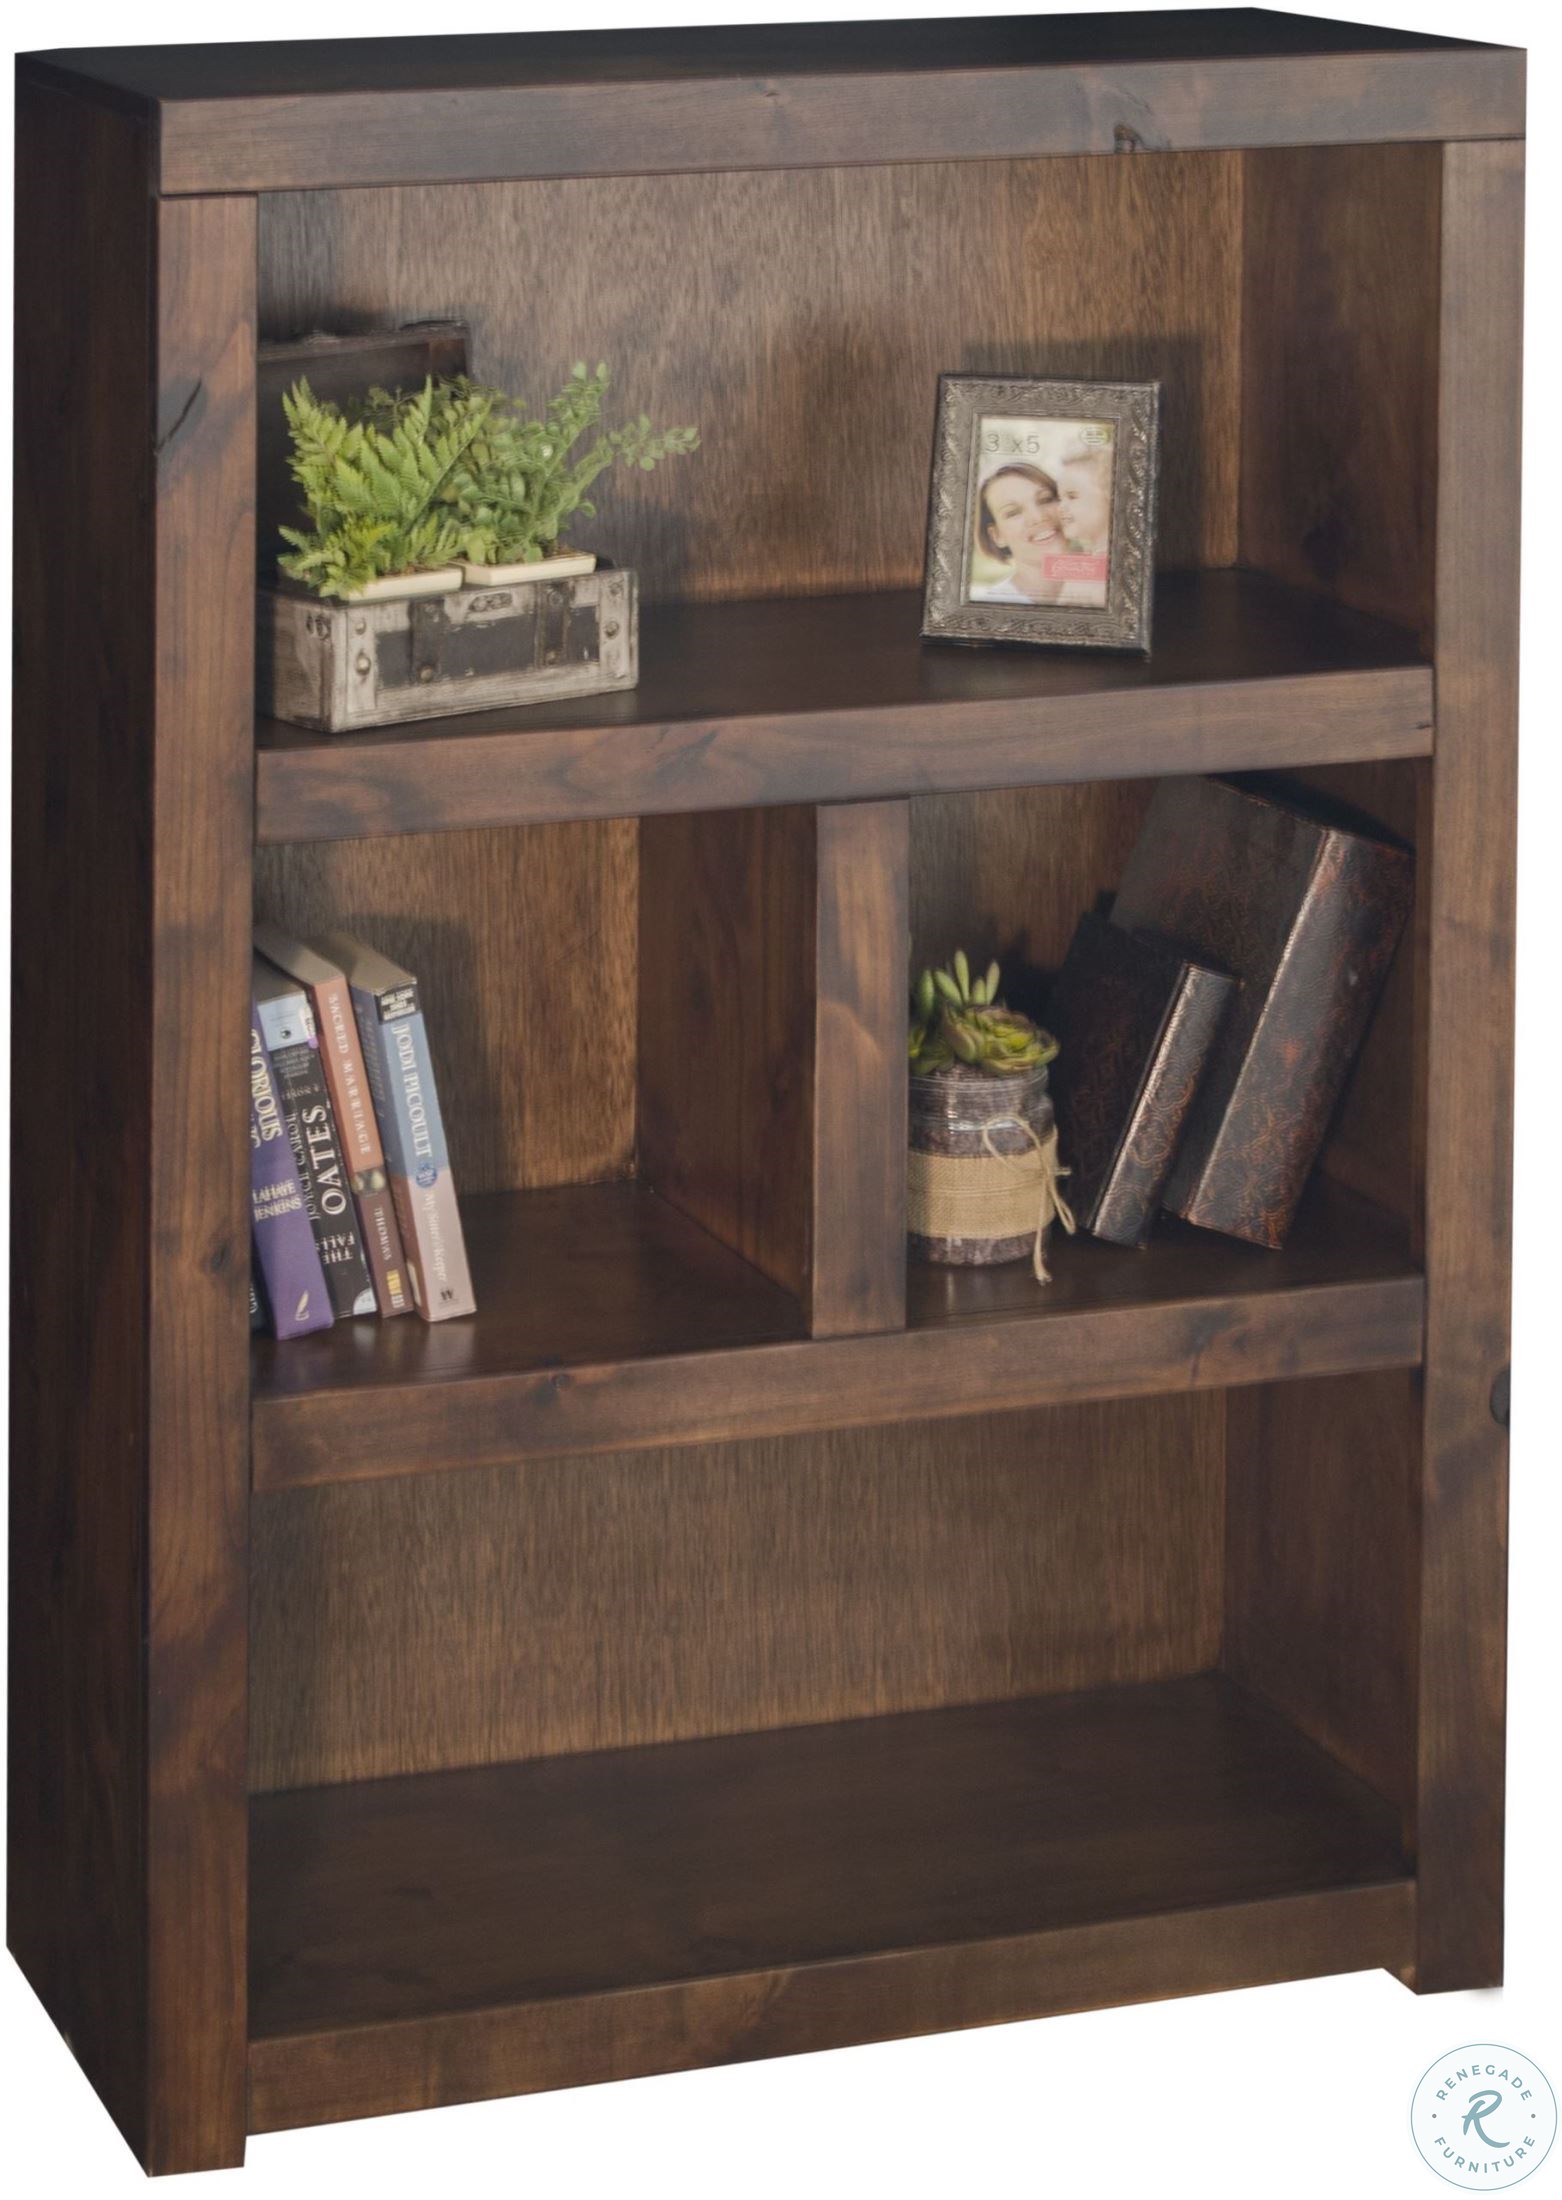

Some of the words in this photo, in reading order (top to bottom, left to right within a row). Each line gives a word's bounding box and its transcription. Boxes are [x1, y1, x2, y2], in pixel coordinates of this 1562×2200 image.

[985, 434, 1000, 453] 3
[328, 992, 349, 1055] SACRED
[343, 1063, 371, 1155] MARRIAGE
[391, 1023, 417, 1072] JODI
[403, 1072, 432, 1158] PICOULT
[302, 1104, 347, 1215] OATES
[322, 1246, 354, 1264] THE
